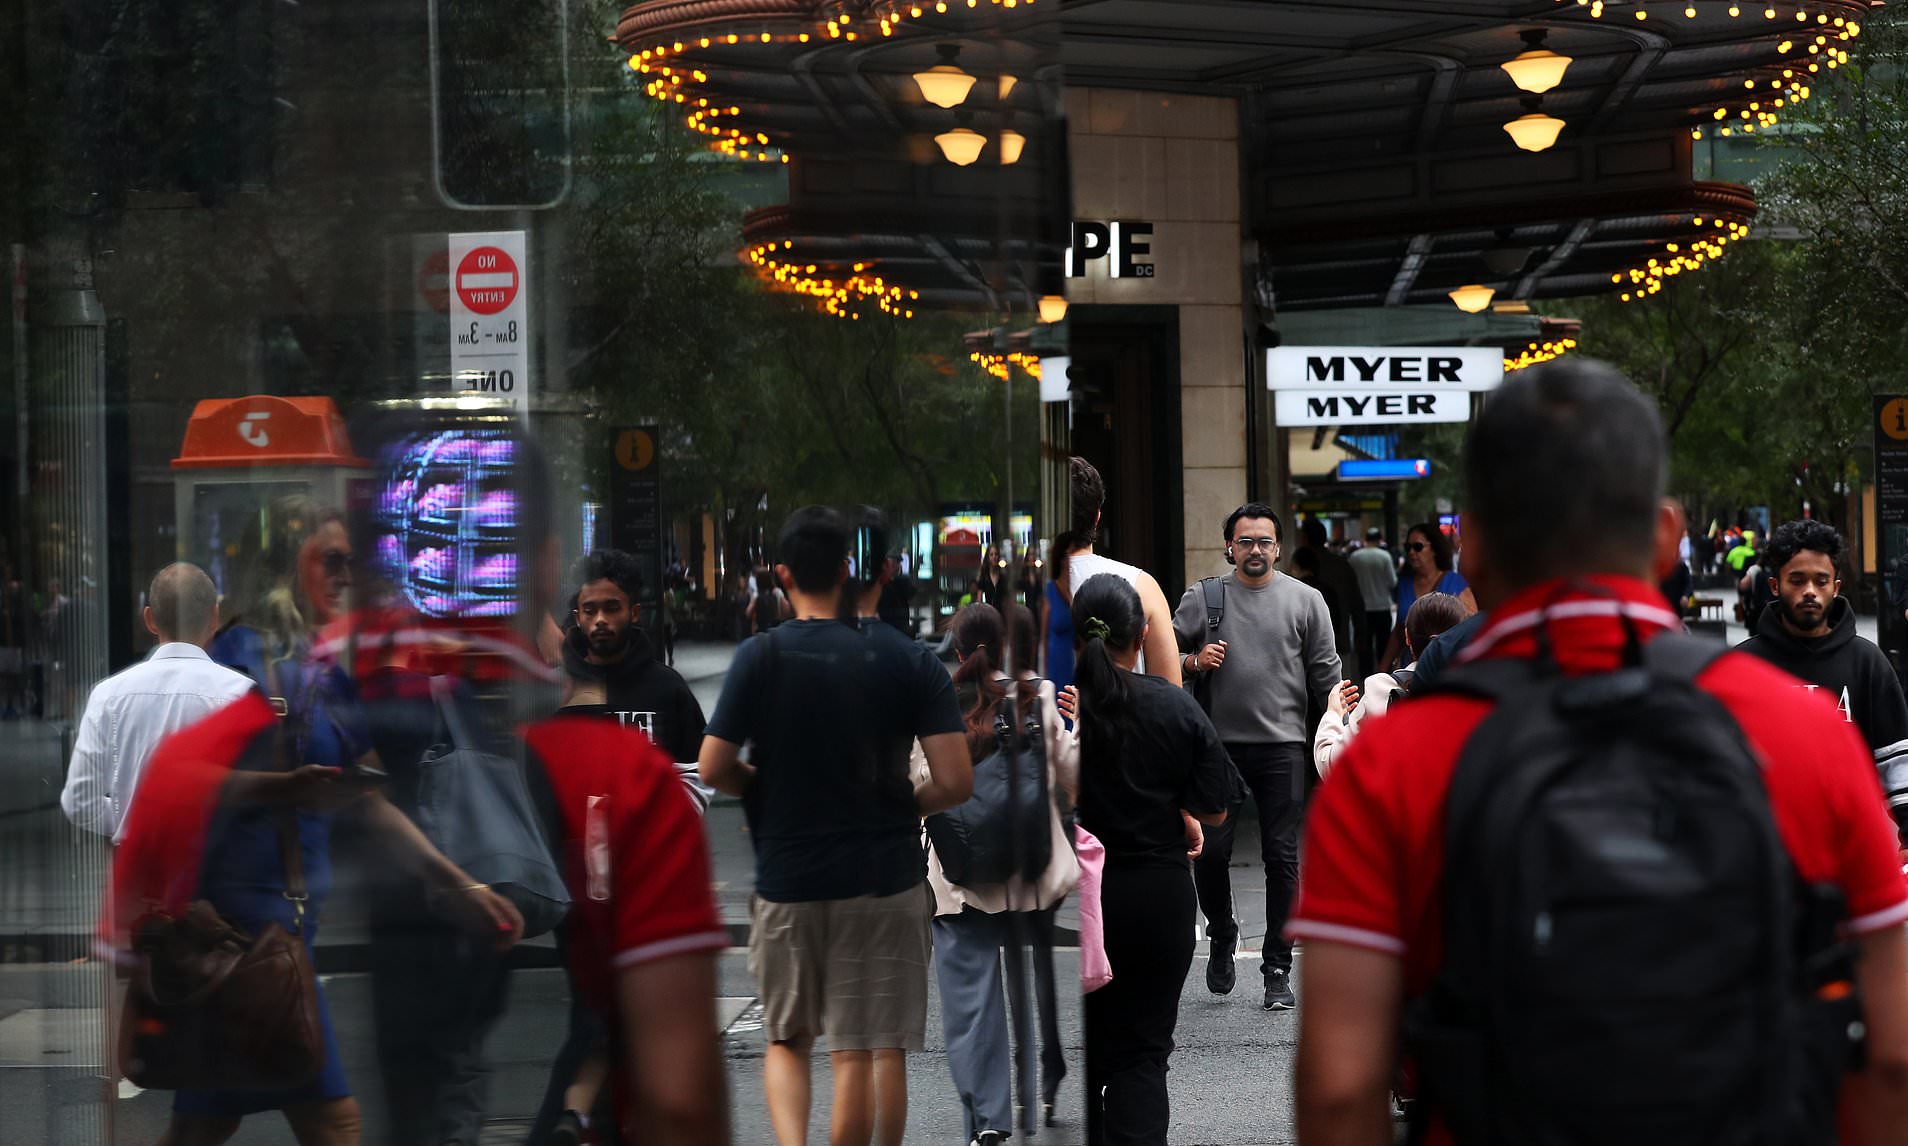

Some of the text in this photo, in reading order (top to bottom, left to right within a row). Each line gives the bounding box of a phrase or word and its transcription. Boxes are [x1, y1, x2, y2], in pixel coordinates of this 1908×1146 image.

[1135, 265, 1153, 277] DC
[1306, 356, 1463, 382] MYER
[1307, 394, 1436, 418] MYER
